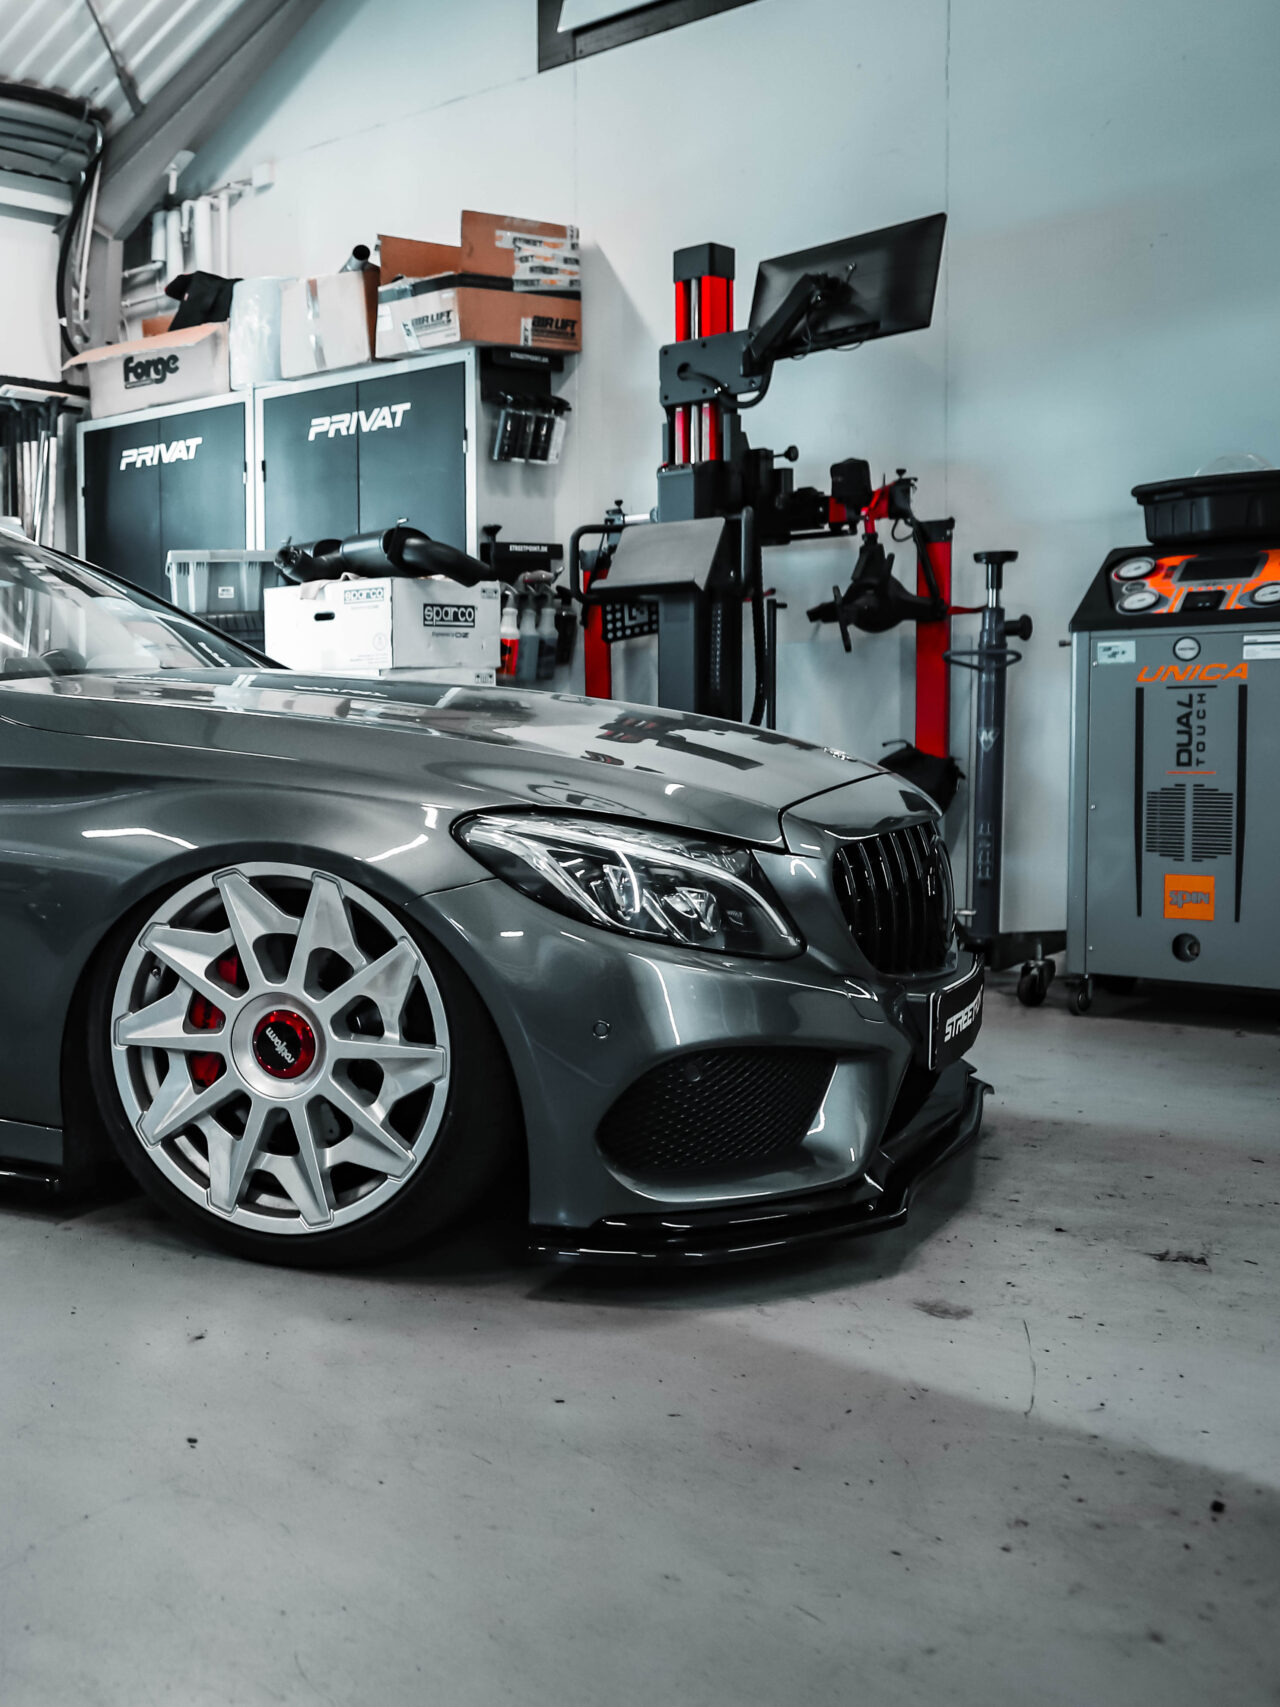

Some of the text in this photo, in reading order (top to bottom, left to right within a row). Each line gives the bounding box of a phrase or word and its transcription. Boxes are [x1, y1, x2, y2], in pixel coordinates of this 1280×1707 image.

[123, 354, 179, 384] Forge
[308, 402, 411, 441] PRIVAT
[120, 437, 202, 470] PRIVAT
[344, 588, 385, 603] sparco
[424, 606, 475, 627] sparco
[1136, 662, 1248, 682] UNICA
[1176, 693, 1193, 767] DUAL
[1195, 693, 1207, 767] TOUCH
